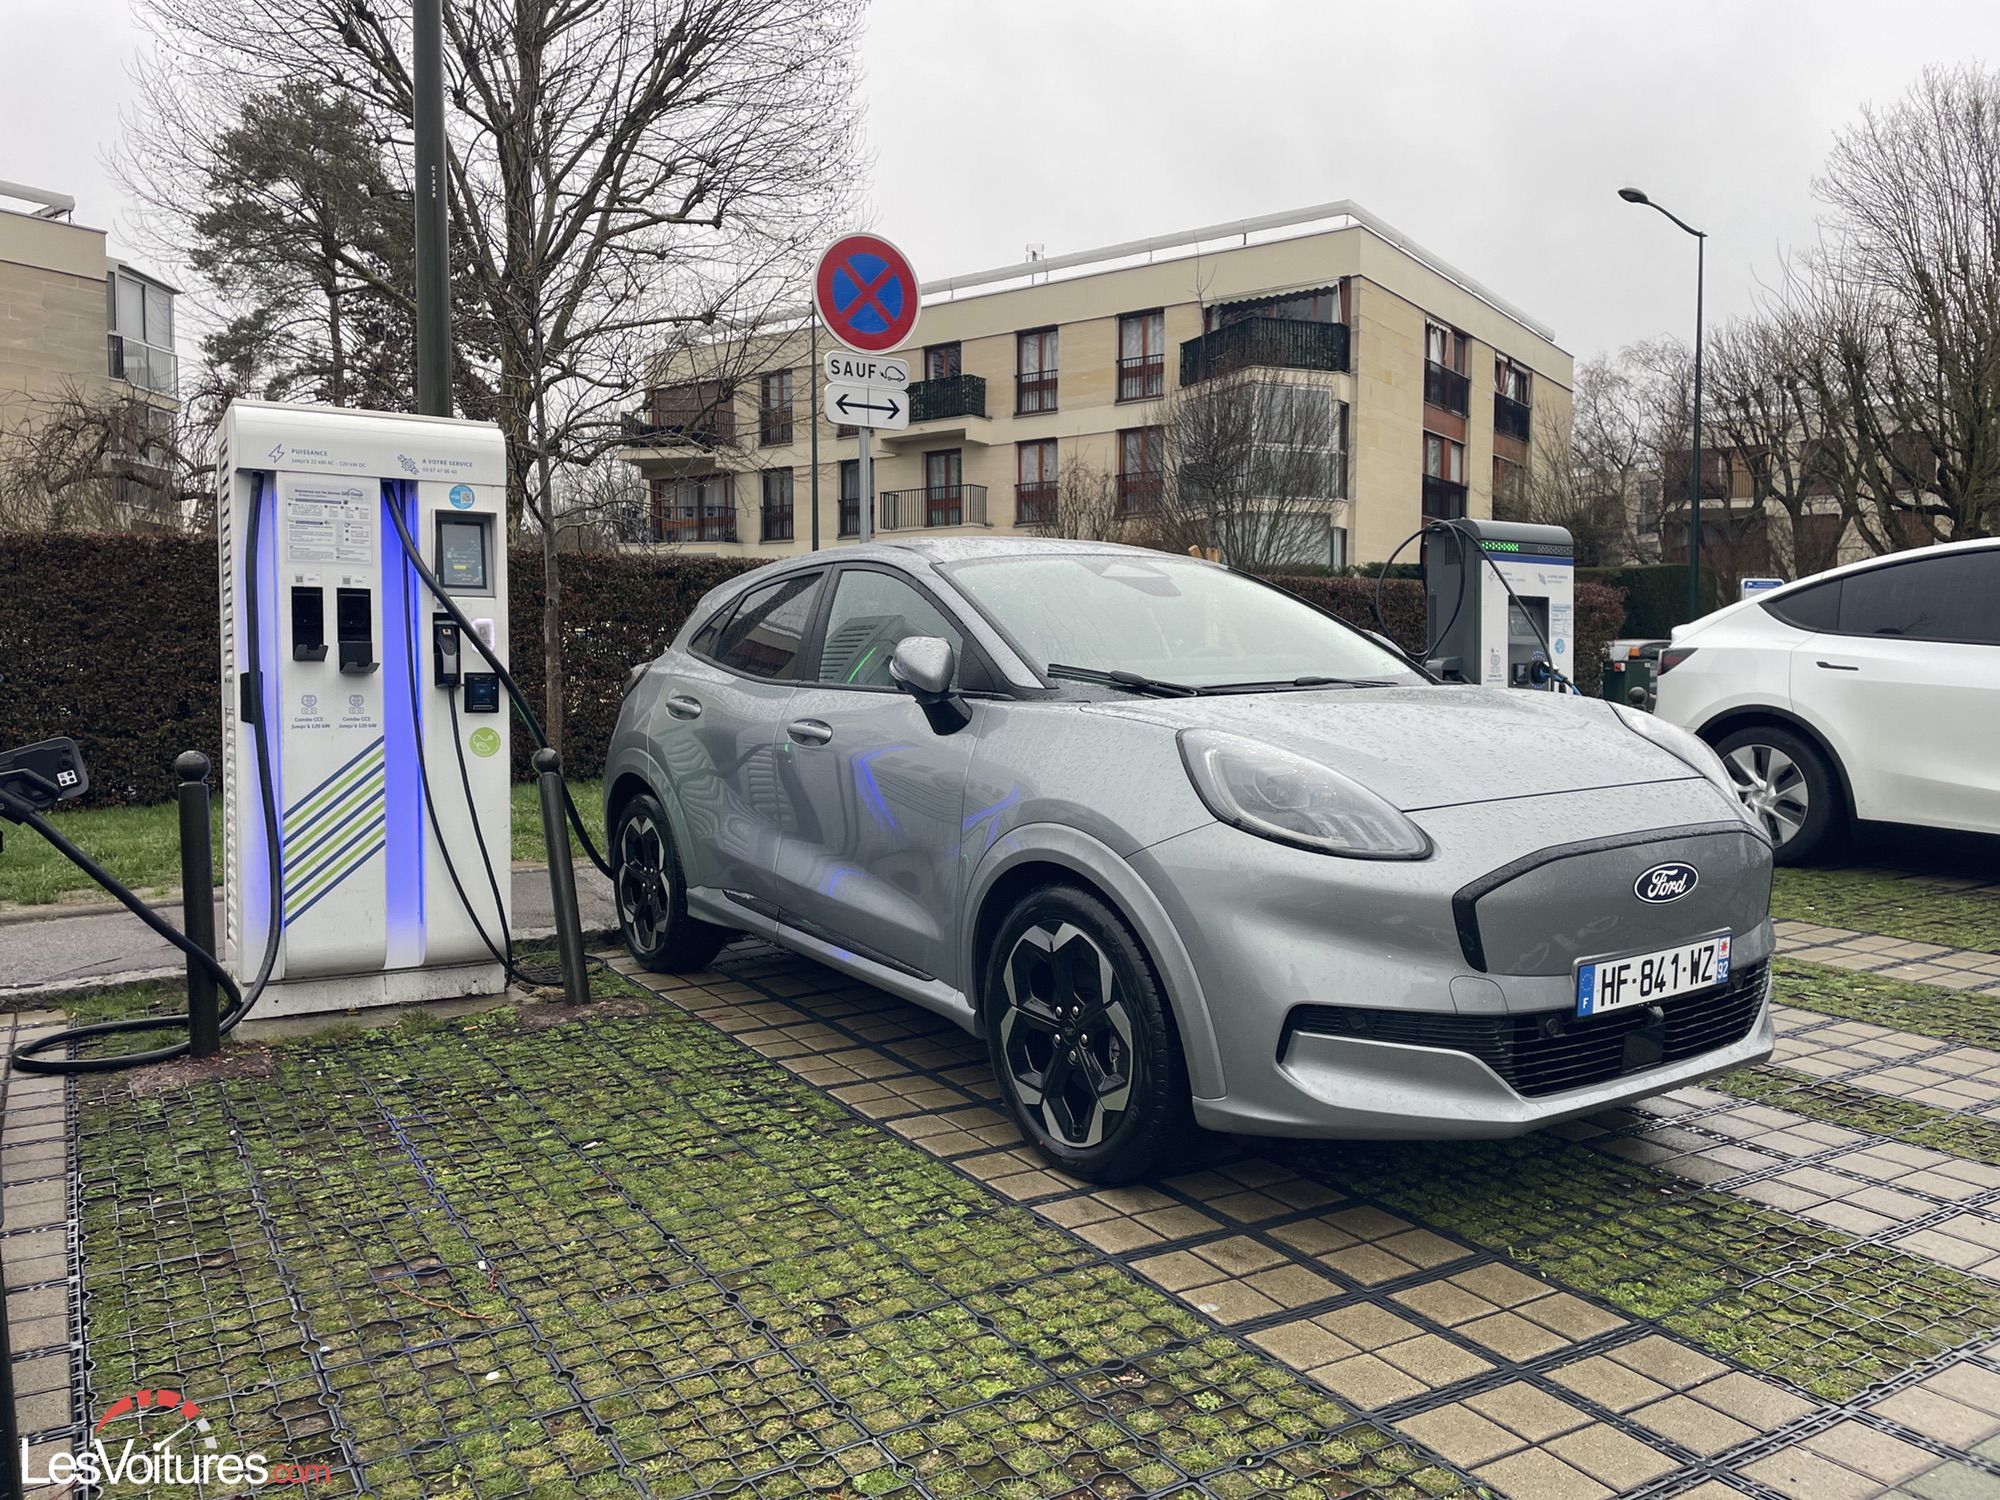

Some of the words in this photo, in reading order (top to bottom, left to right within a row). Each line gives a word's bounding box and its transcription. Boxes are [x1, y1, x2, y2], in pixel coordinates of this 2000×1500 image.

[830, 359, 877, 379] SAUF
[291, 448, 328, 457] PUISSANCE
[448, 460, 473, 468] SERVICE
[1647, 869, 1687, 898] Ford
[1582, 997, 1589, 1009] F
[1600, 945, 1715, 1007] HF-841-WZ
[1717, 961, 1729, 979] 92
